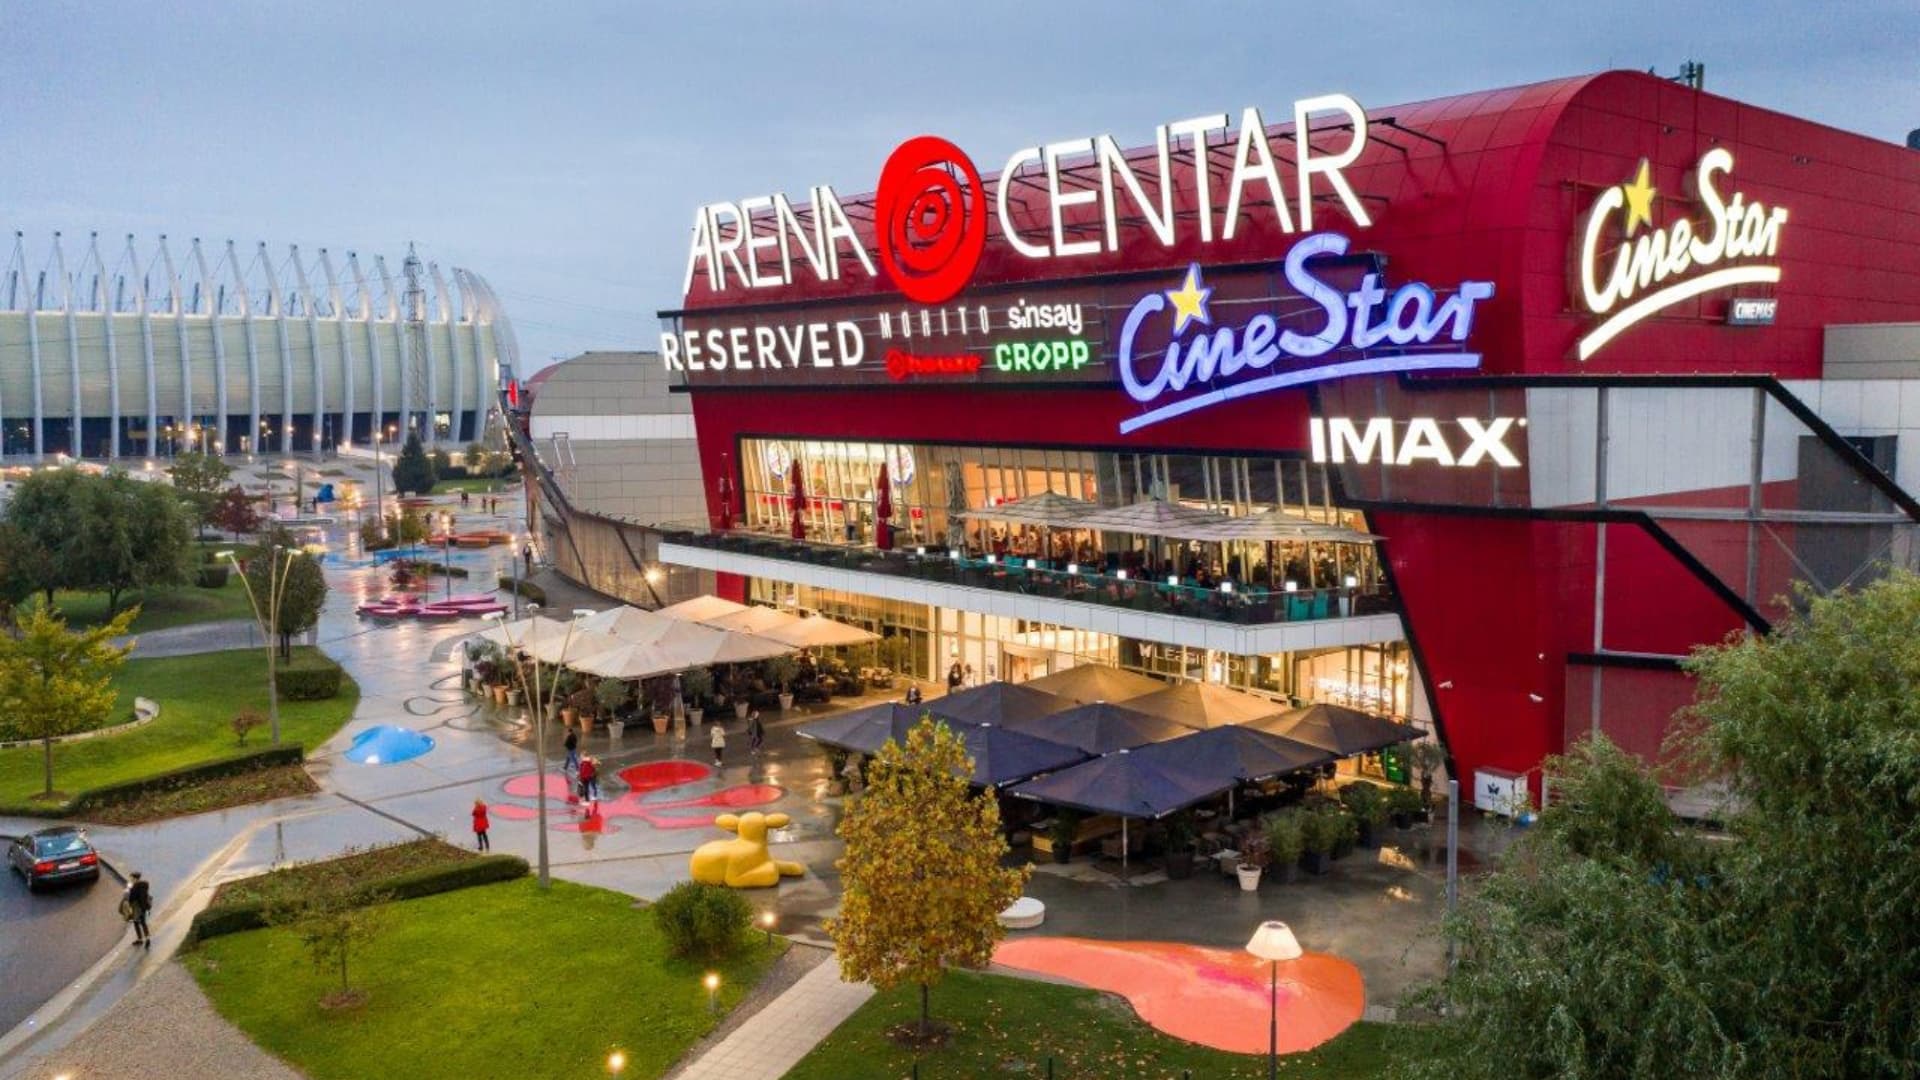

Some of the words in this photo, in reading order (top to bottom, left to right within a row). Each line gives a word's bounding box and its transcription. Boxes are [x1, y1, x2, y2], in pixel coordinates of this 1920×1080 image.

[682, 185, 877, 295] ARENA
[997, 93, 1373, 258] CENTAR
[1581, 147, 1789, 314] CineStar
[879, 305, 990, 339] MOHITO
[1008, 299, 1084, 335] sinsay
[1119, 232, 1496, 403] CineStar
[660, 321, 865, 373] RESERVED
[995, 340, 1090, 372] CROPP
[1309, 417, 1523, 468] IMAX
